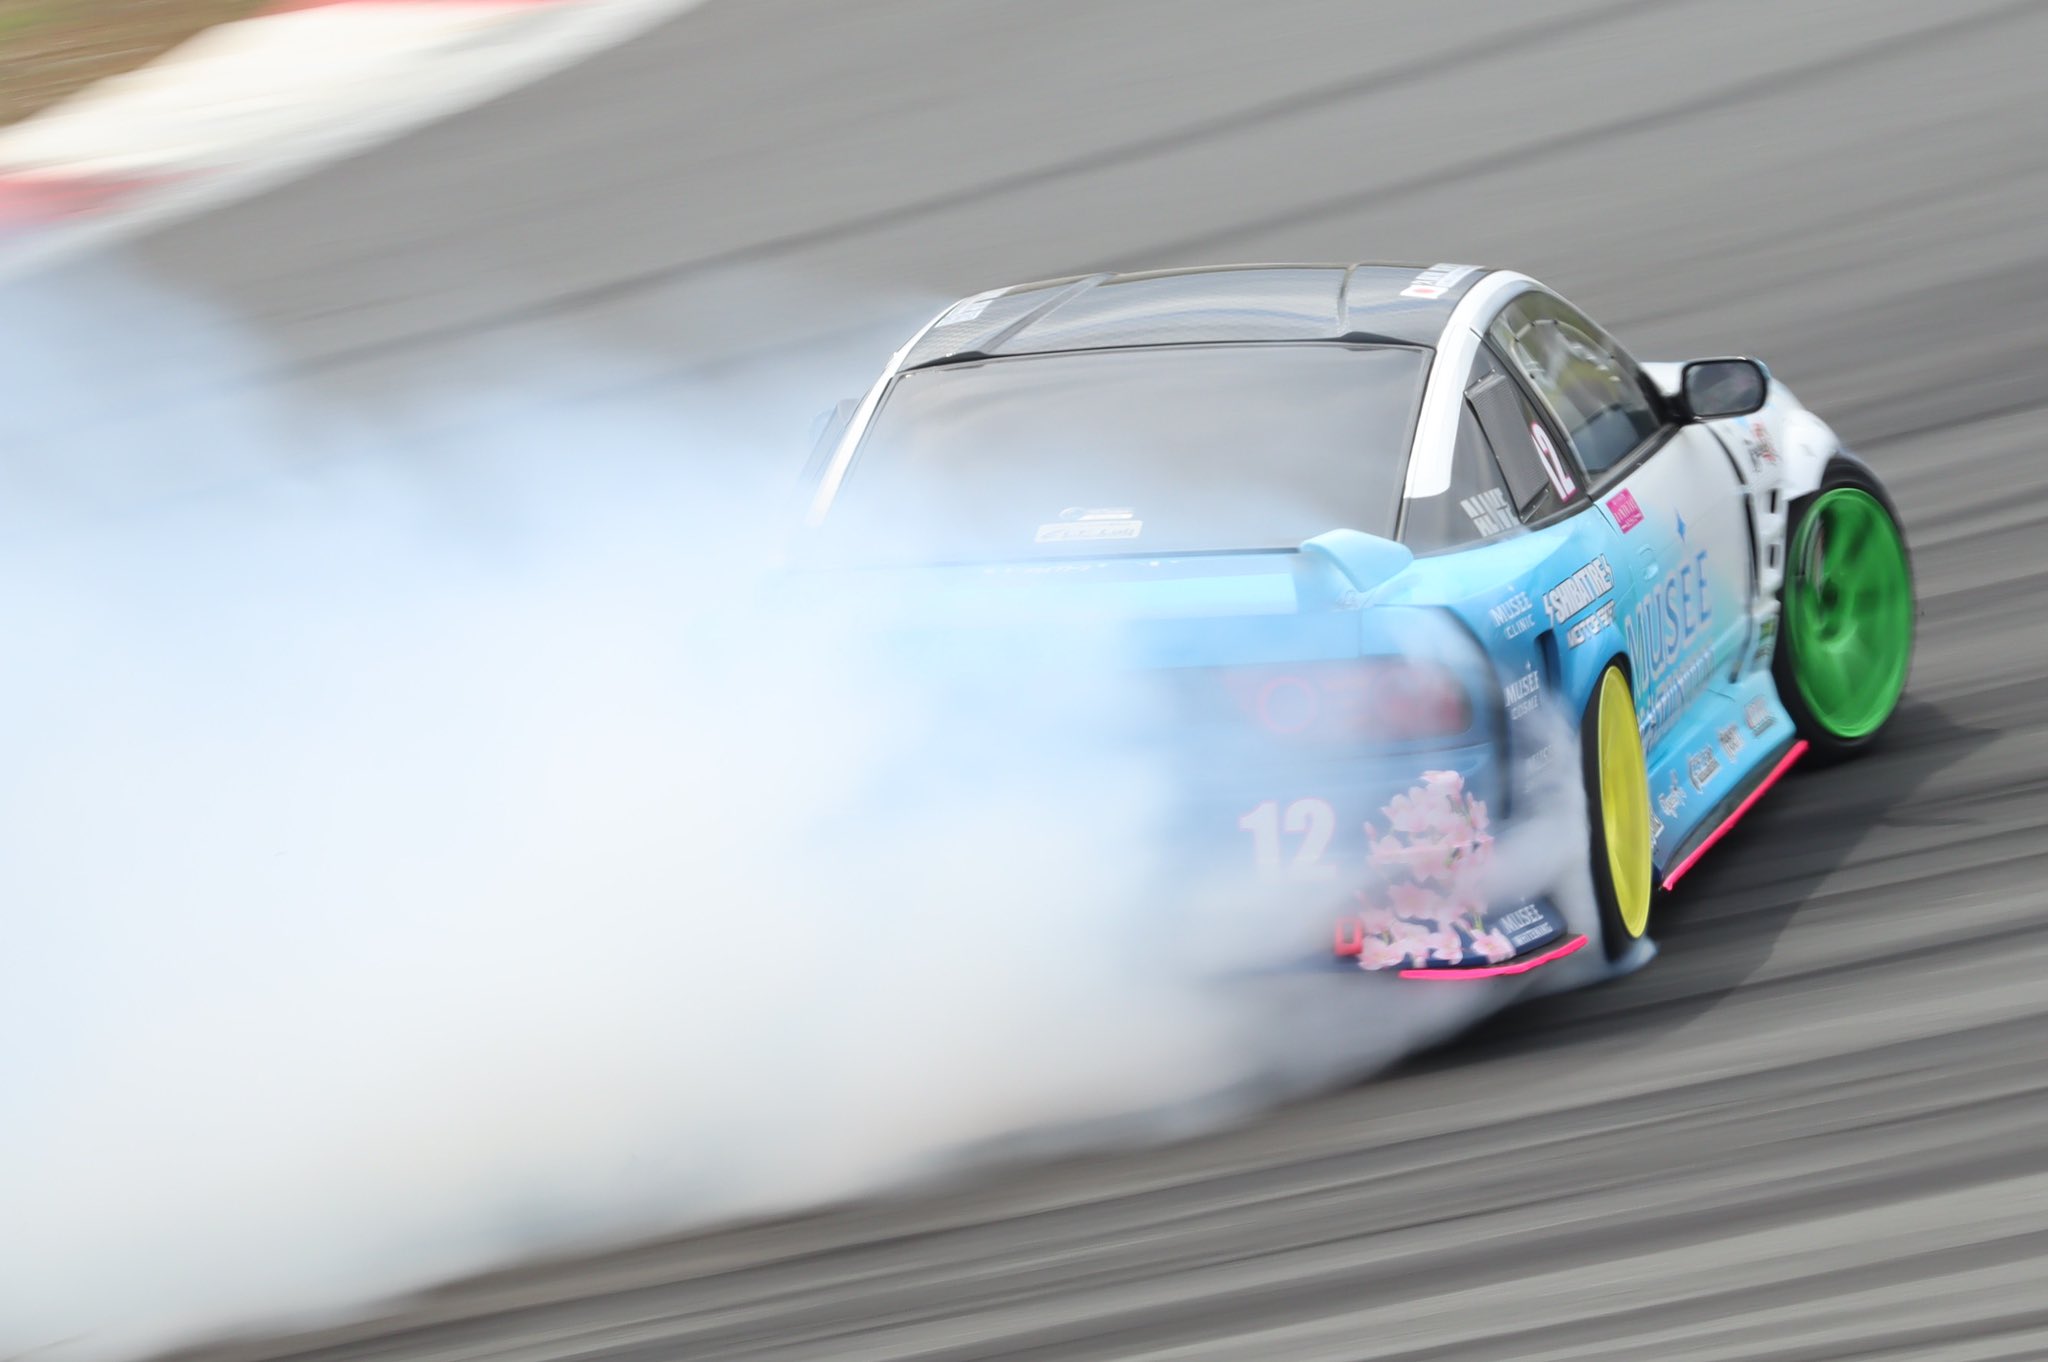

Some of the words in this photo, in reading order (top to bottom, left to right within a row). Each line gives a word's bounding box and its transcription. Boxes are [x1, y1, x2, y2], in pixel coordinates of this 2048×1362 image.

[1489, 591, 1533, 628] MUSEE
[1625, 549, 1714, 698] MUSEE
[1503, 670, 1540, 708] MUSEE
[1237, 797, 1339, 881] 12
[1500, 903, 1544, 935] MUSEE
